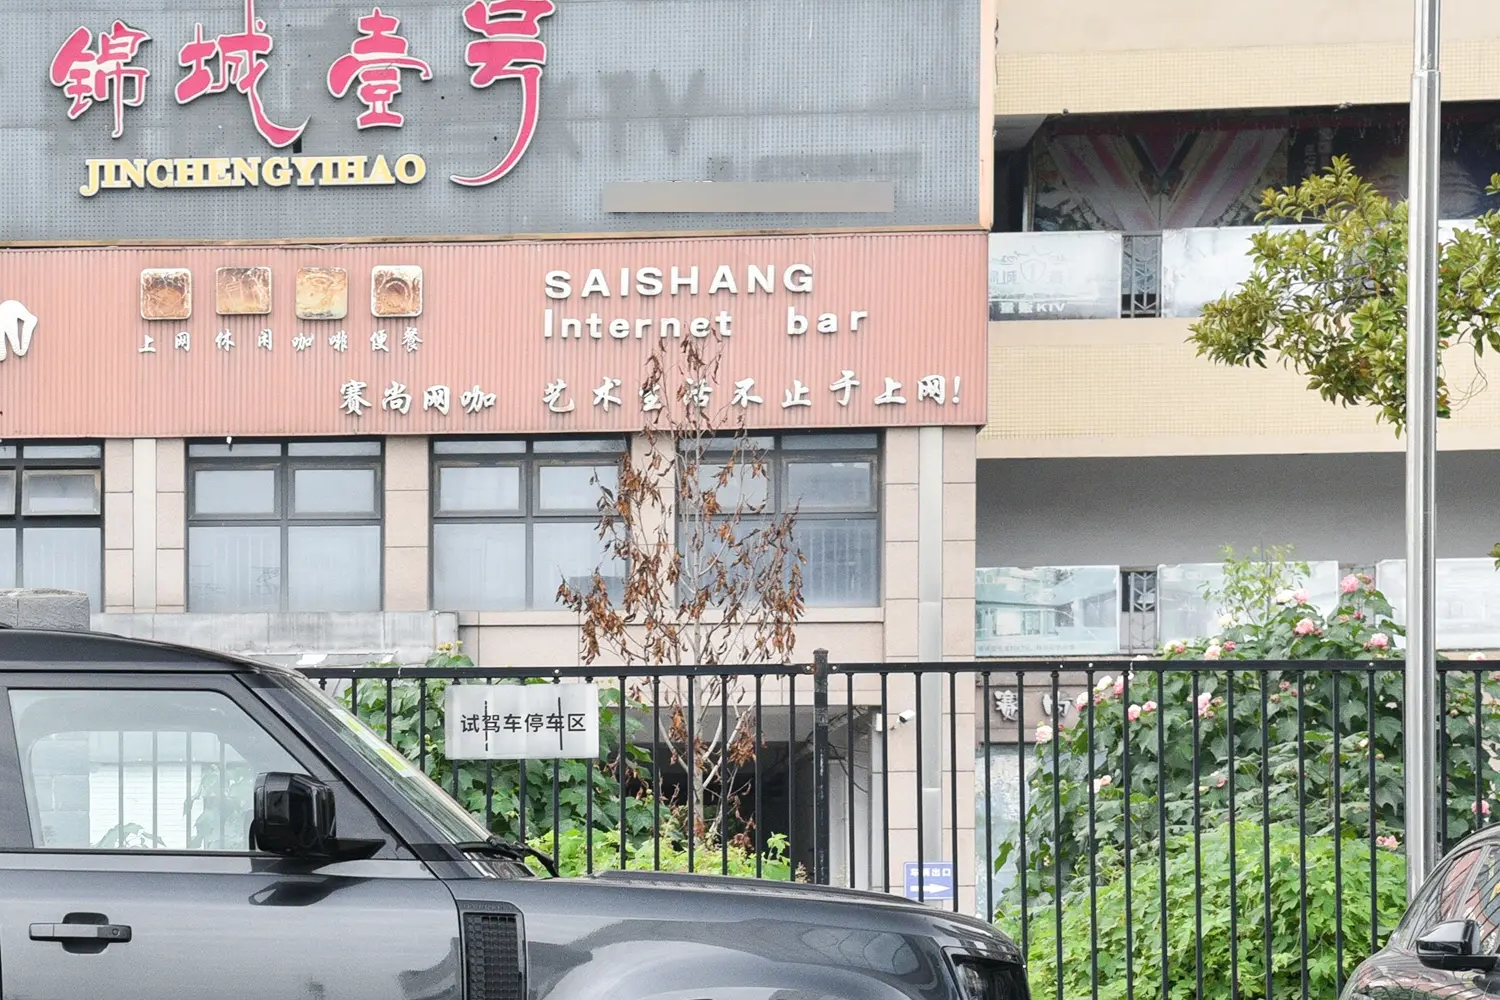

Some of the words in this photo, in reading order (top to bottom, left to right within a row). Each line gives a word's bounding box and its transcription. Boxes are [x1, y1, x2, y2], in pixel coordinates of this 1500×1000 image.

[50, 0, 555, 187] 锦城壹号
[79, 153, 427, 198] JINCHENGYIHAO
[544, 263, 814, 299] SAISHANG
[138, 331, 191, 353] 上网
[215, 328, 273, 352] 休闲
[291, 329, 348, 353] 咖啡
[369, 326, 424, 353] 便餐
[543, 309, 733, 339] Internet
[787, 306, 868, 336] bar
[339, 379, 497, 416] 赛尚网咖
[460, 713, 587, 733] 试驾车停车区
